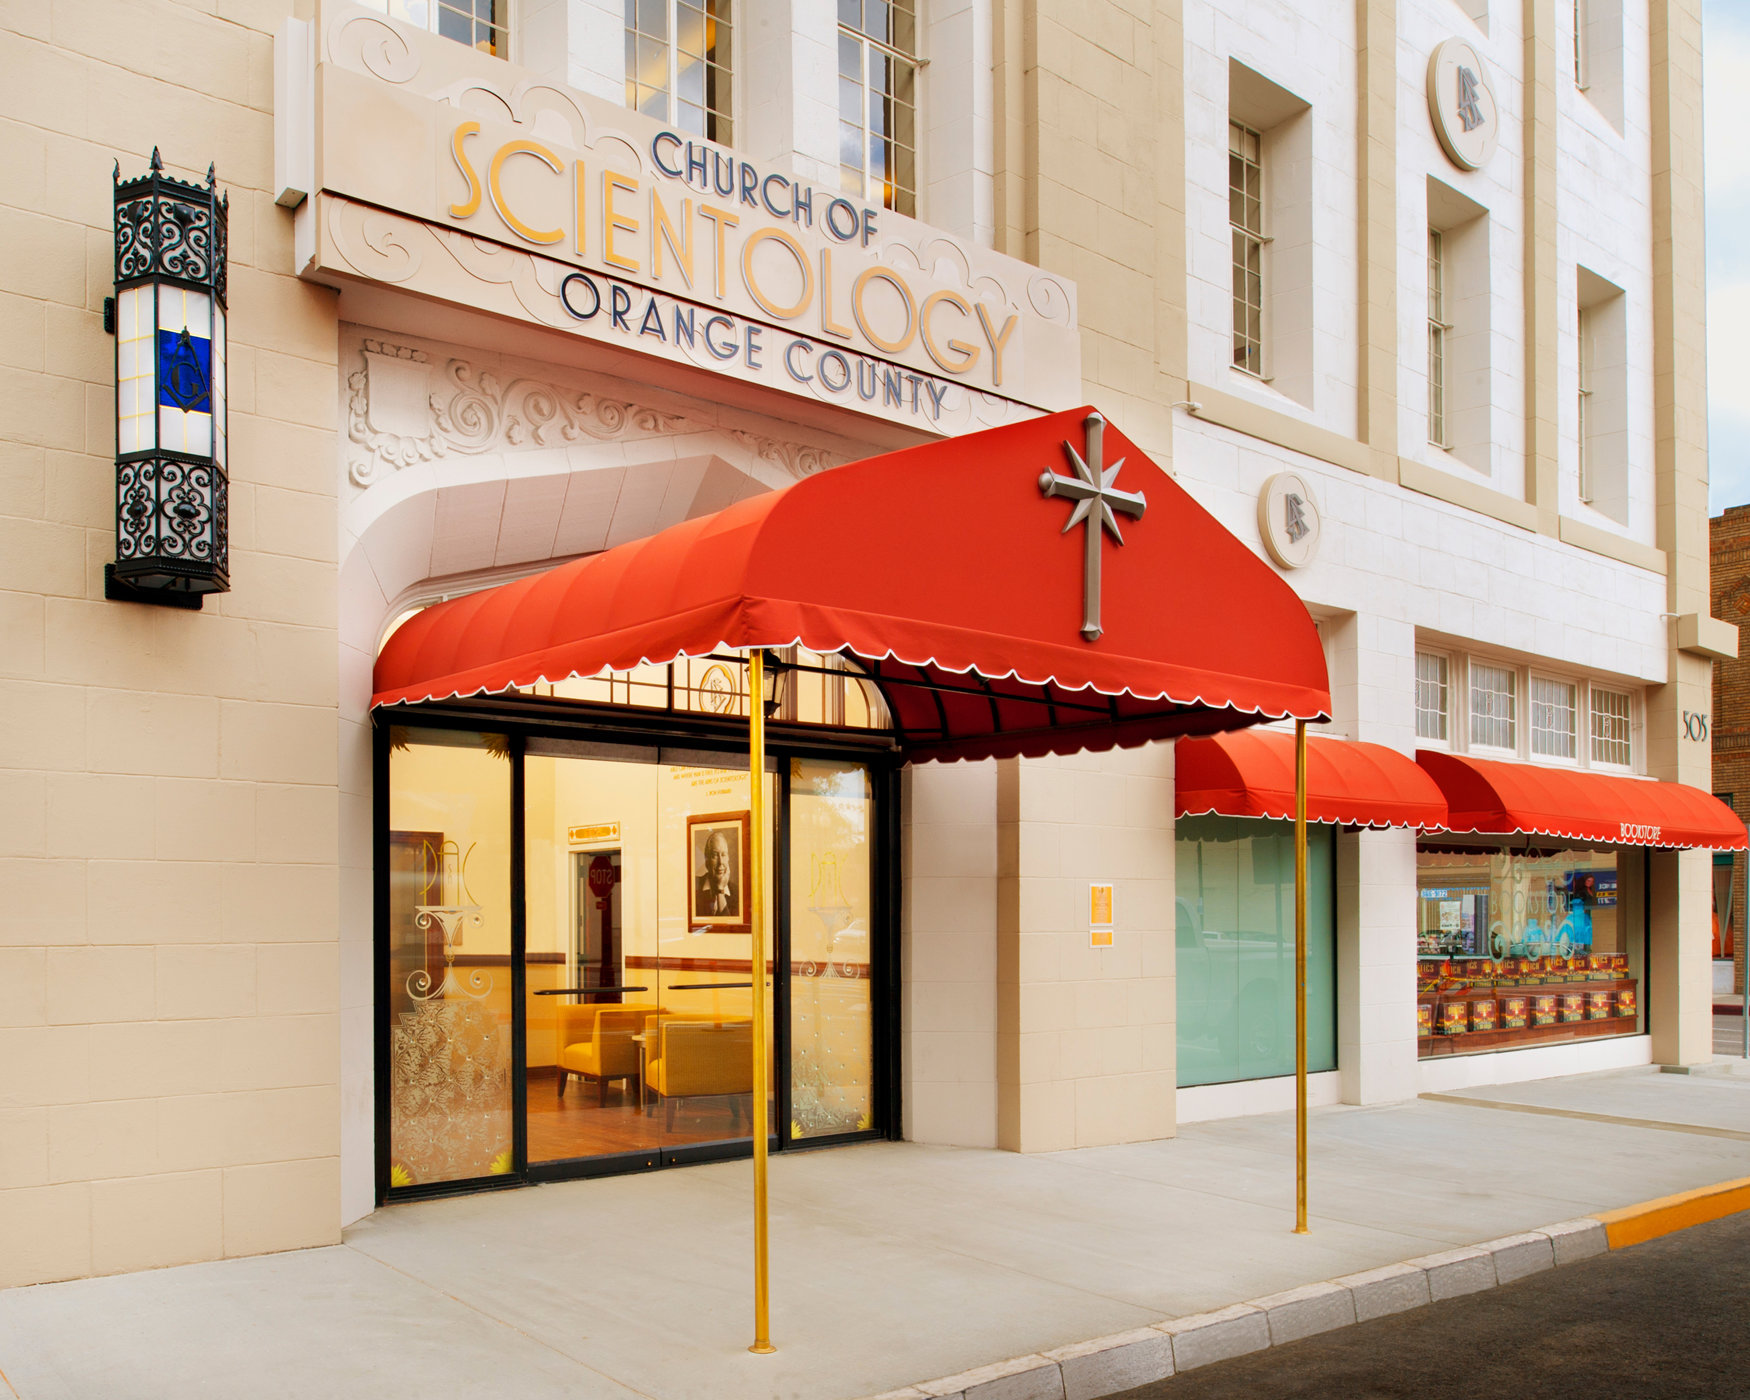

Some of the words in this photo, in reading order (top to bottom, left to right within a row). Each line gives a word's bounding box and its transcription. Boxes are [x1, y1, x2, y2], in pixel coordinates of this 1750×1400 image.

[651, 131, 815, 228] CHURCH
[826, 198, 879, 247] OF
[449, 121, 1018, 387] SCIENTOLOGY
[559, 273, 765, 370] ORANGE
[784, 338, 949, 421] COUNTY
[1682, 710, 1708, 742] 505
[1620, 822, 1661, 840] BOOKSTORE
[1491, 890, 1574, 914] BOOKSTORE
